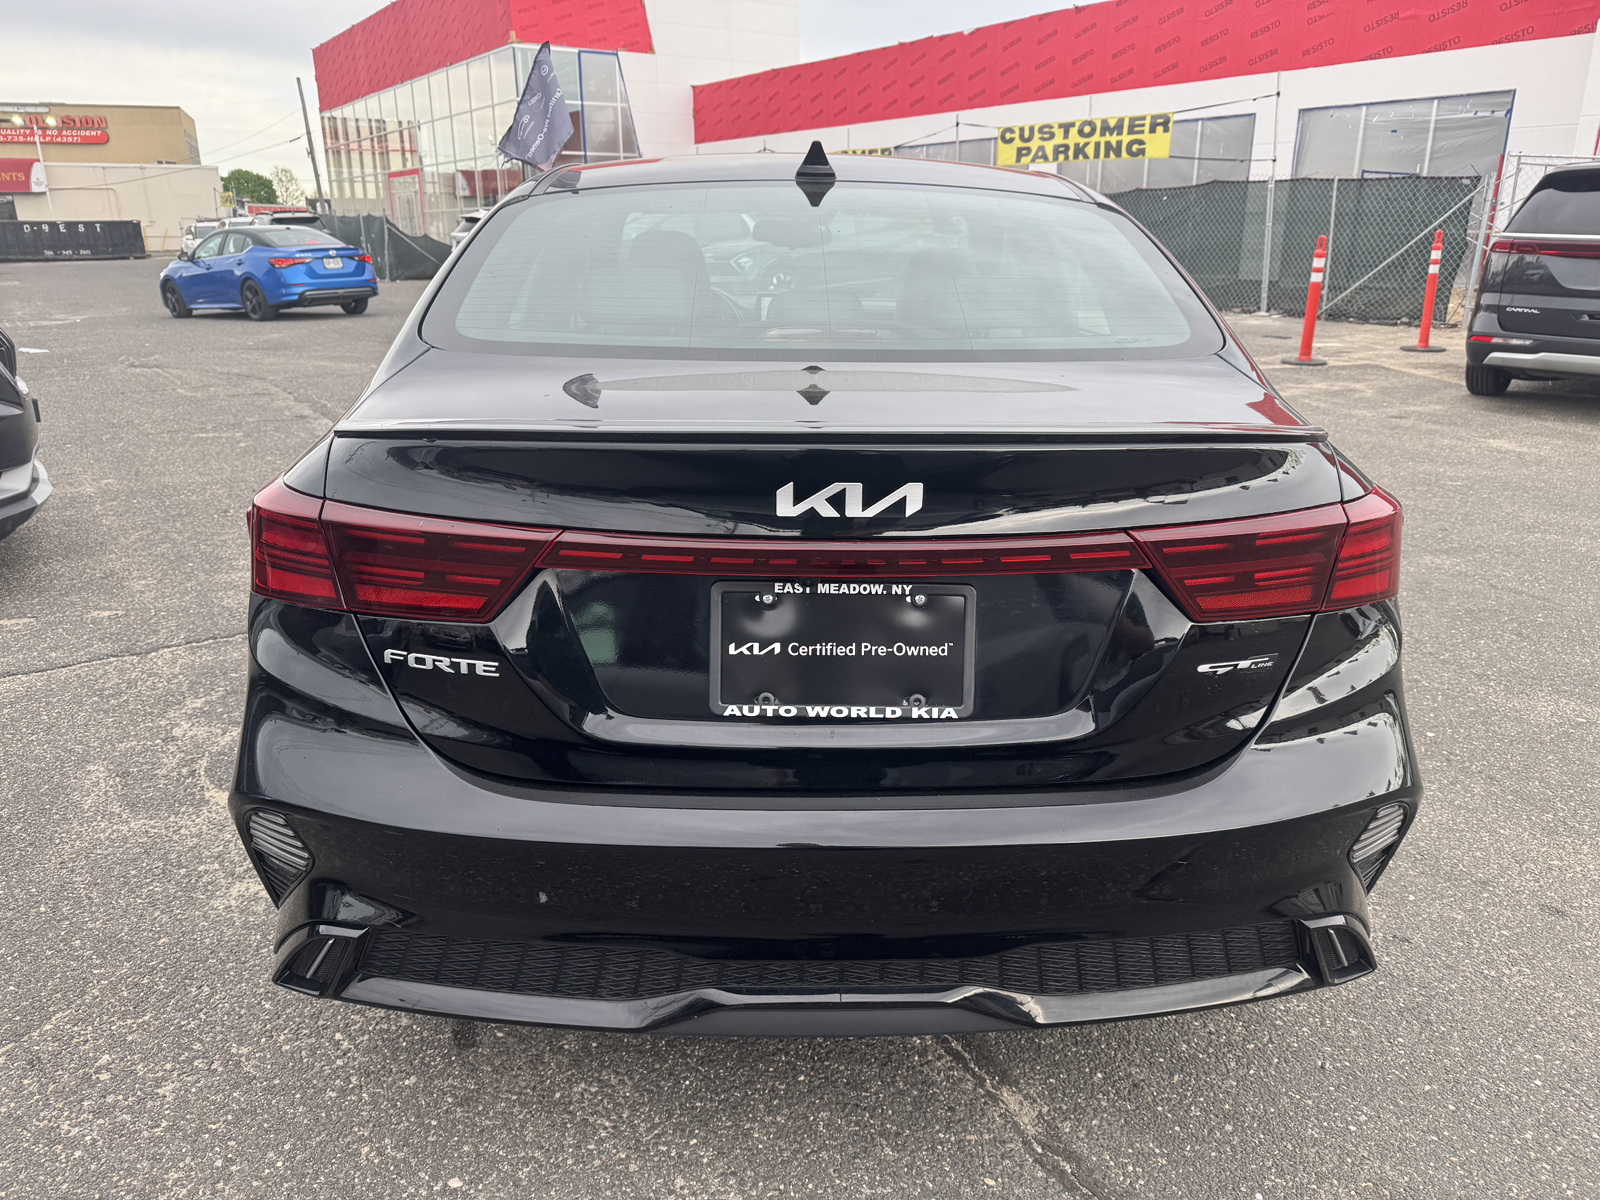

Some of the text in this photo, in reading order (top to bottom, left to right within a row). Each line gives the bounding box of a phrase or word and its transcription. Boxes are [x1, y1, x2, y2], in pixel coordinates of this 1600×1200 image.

[1428, 0, 1469, 23] RESISTO
[1249, 19, 1281, 40] RESISTO
[1363, 10, 1400, 34] RESISTO
[1154, 35, 1181, 55] RESISTO
[1200, 27, 1230, 47] RESISTO
[1111, 42, 1136, 61] RESISTO
[1247, 47, 1279, 67] RESISTO
[1301, 37, 1335, 59] RESISTO
[1358, 46, 1393, 61] SISTO
[1199, 55, 1227, 74] RESISTO
[13, 115, 107, 128] OLISION
[1000, 114, 1171, 144] CUSTOMER
[1014, 138, 1147, 163] PARKING
[0, 172, 25, 181] NTS
[776, 481, 924, 518] KIA
[891, 584, 913, 595] NY
[728, 642, 781, 655] KIA
[788, 642, 856, 656] Certified
[384, 649, 499, 677] FORTE
[1250, 661, 1274, 669] LINE
[723, 705, 959, 719] AUTO WORLD KIA
